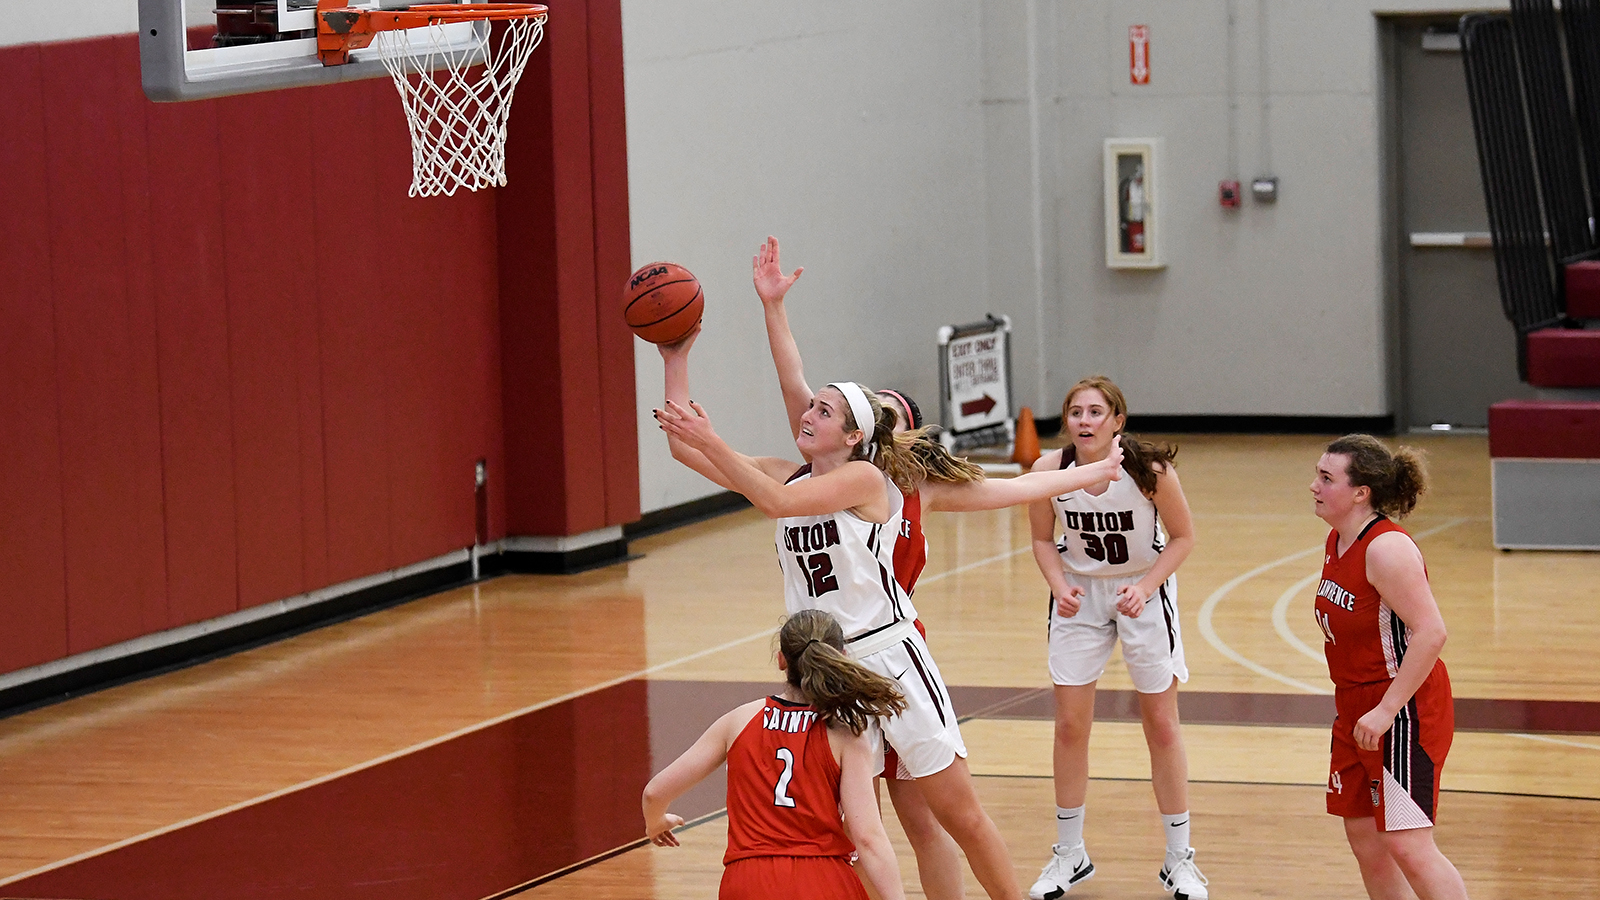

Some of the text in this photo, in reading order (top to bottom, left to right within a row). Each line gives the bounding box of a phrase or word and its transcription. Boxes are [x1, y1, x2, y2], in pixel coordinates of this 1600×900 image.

[631, 266, 669, 291] NCAA
[952, 336, 996, 358] EXIT ONLY
[953, 361, 975, 380] ENTER
[1064, 509, 1135, 532] UNION
[784, 518, 841, 553] UNION
[1079, 532, 1130, 565] 30
[796, 551, 840, 598] 12
[774, 746, 797, 808] 2
